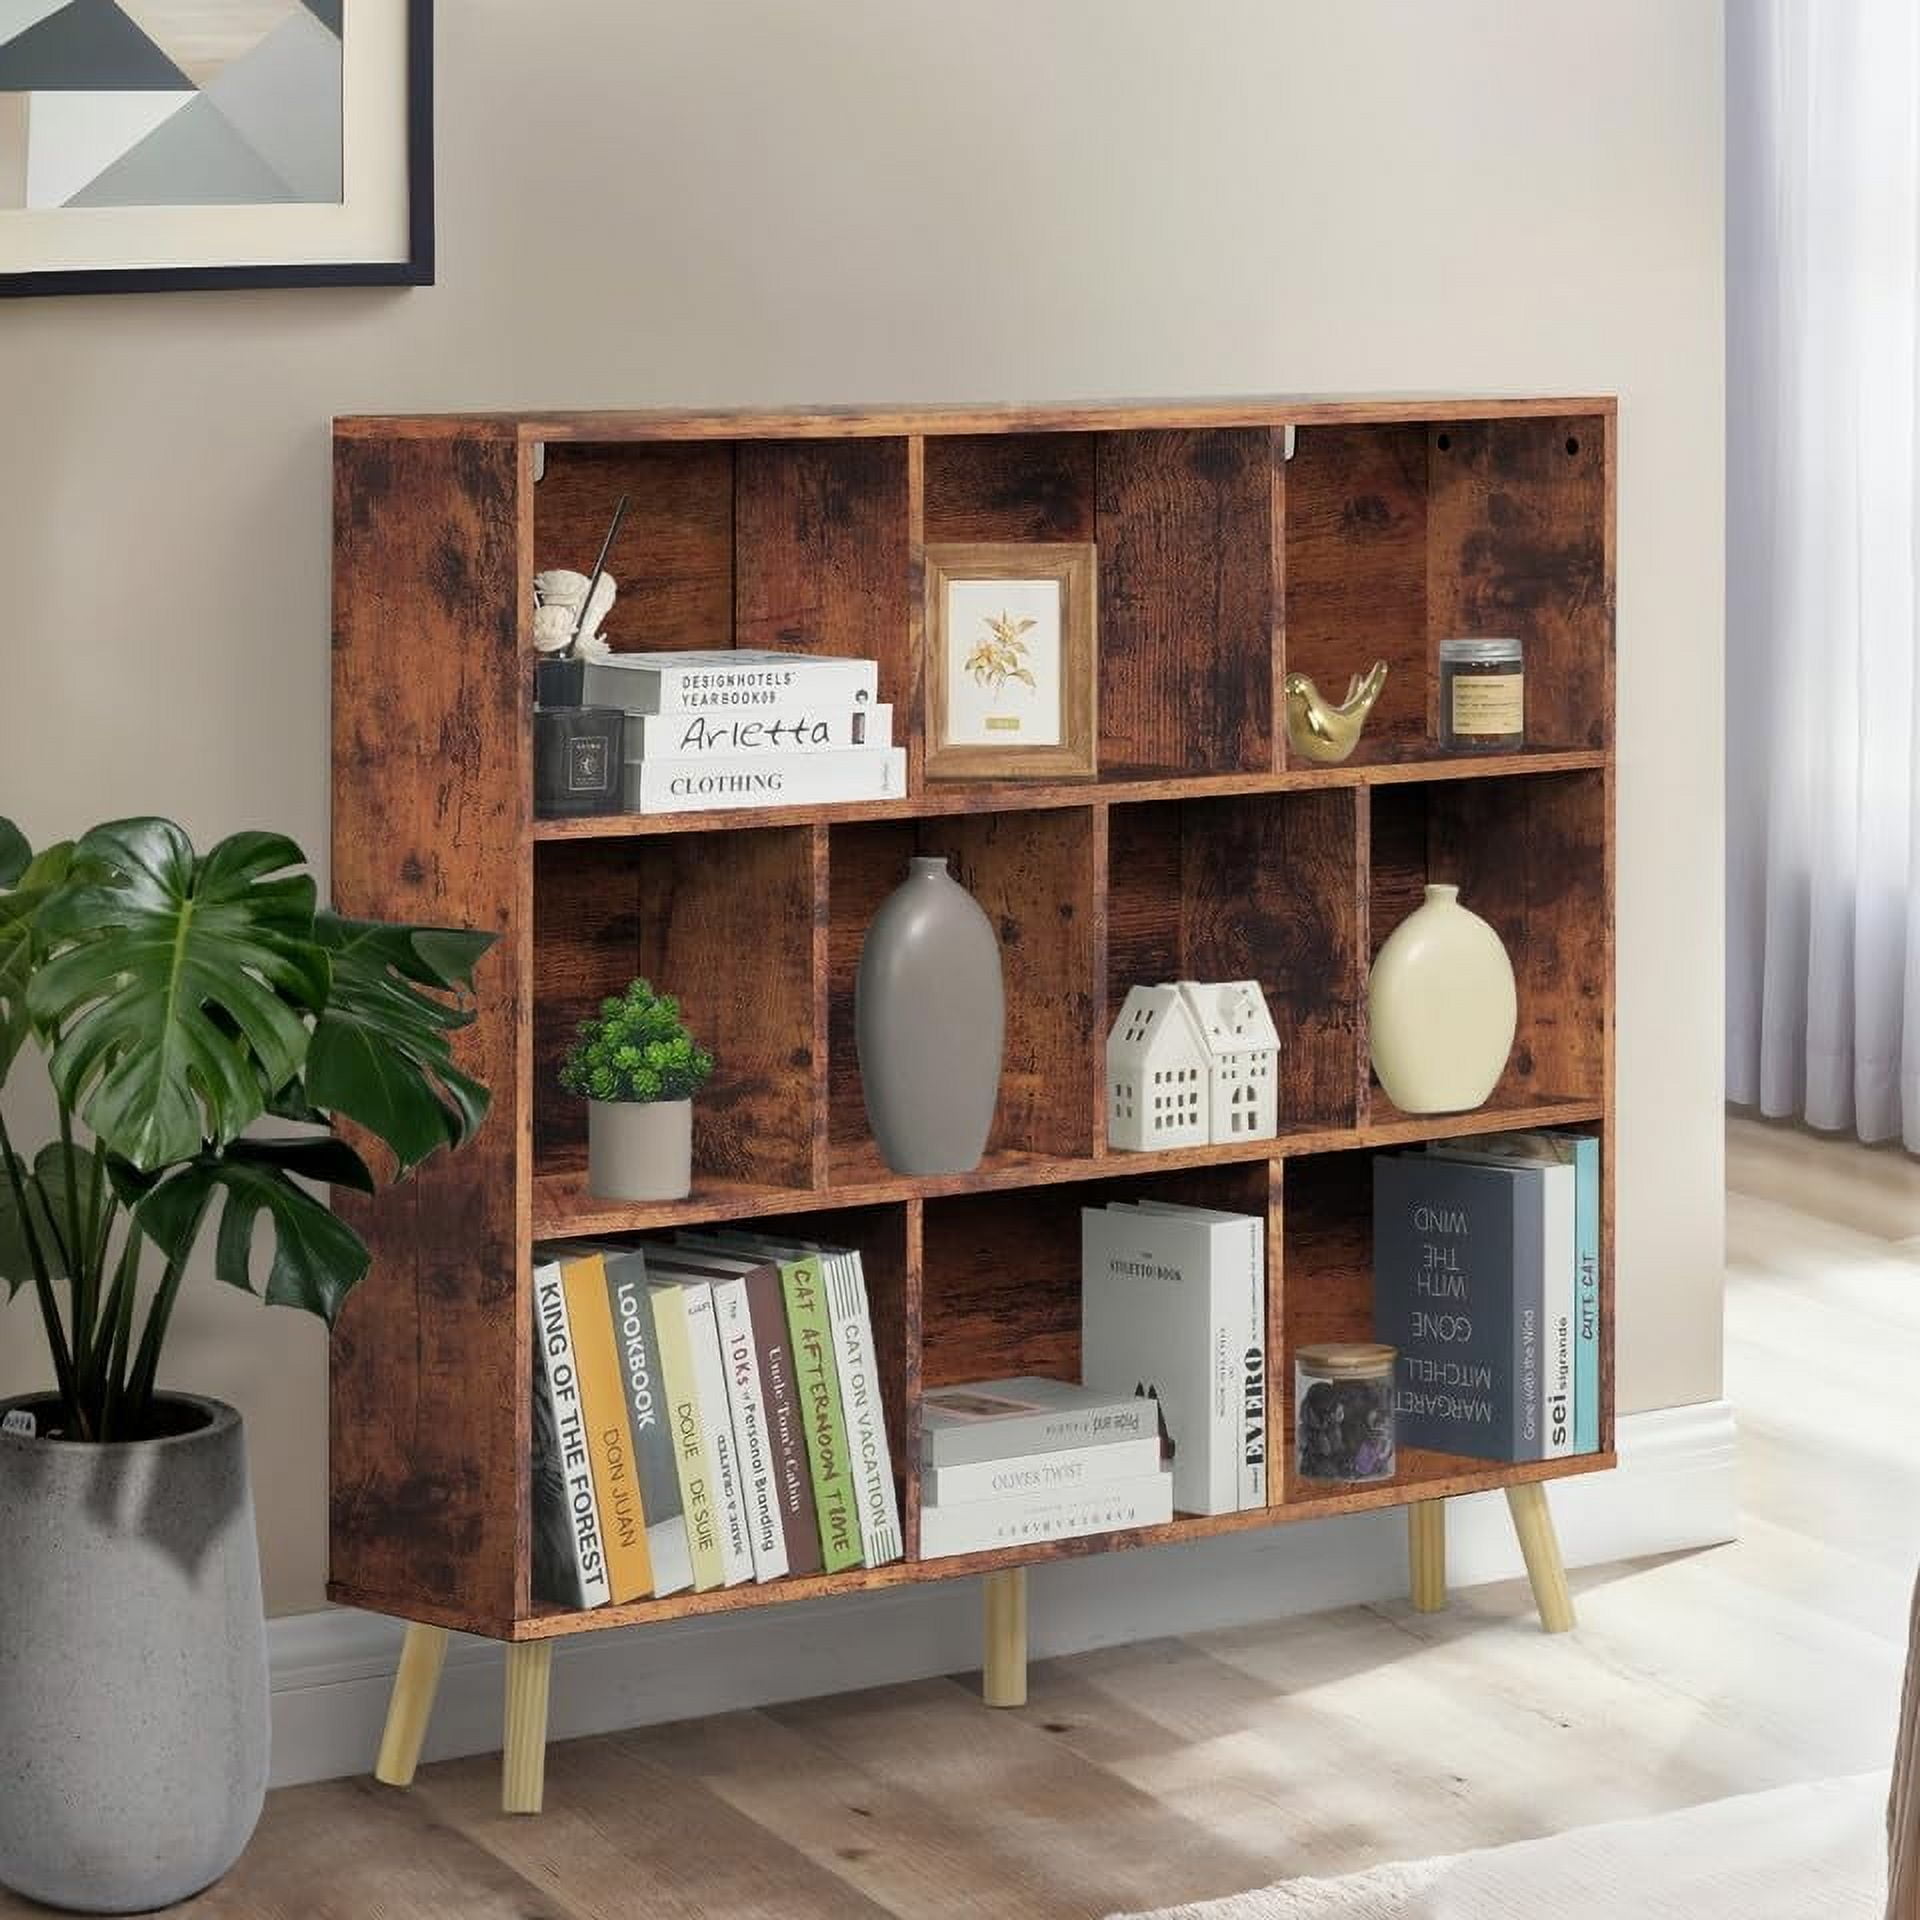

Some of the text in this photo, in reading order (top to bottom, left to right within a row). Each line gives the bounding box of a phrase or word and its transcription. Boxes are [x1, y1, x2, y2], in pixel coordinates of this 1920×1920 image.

[681, 717, 830, 750] Arletta
[671, 772, 783, 796] CLOTHING
[1414, 1206, 1469, 1234] WIND
[1424, 1245, 1458, 1270] THE
[1581, 1250, 1595, 1287] CAT
[1417, 1272, 1467, 1298] WITH
[1412, 1311, 1473, 1343] GONE
[617, 1283, 657, 1429] LOOKBOOK
[1404, 1358, 1492, 1388] MITCHELL
[794, 1270, 851, 1553] CAT AFTERNOON TIME
[1245, 1347, 1264, 1466] EVERO
[1395, 1391, 1492, 1423] MARGARET
[1547, 1394, 1567, 1446] sei
[540, 1282, 605, 1585] KING OF THE FOREST
[731, 1333, 751, 1387] 10Ks
[744, 1403, 764, 1475] Personal
[755, 1477, 775, 1552] Branding
[768, 1346, 786, 1400] Uncle
[785, 1458, 802, 1513] Cabin
[845, 1324, 886, 1527] CAT ON VACATION
[603, 1429, 636, 1548] DON JUAN
[689, 1479, 707, 1507] DE
